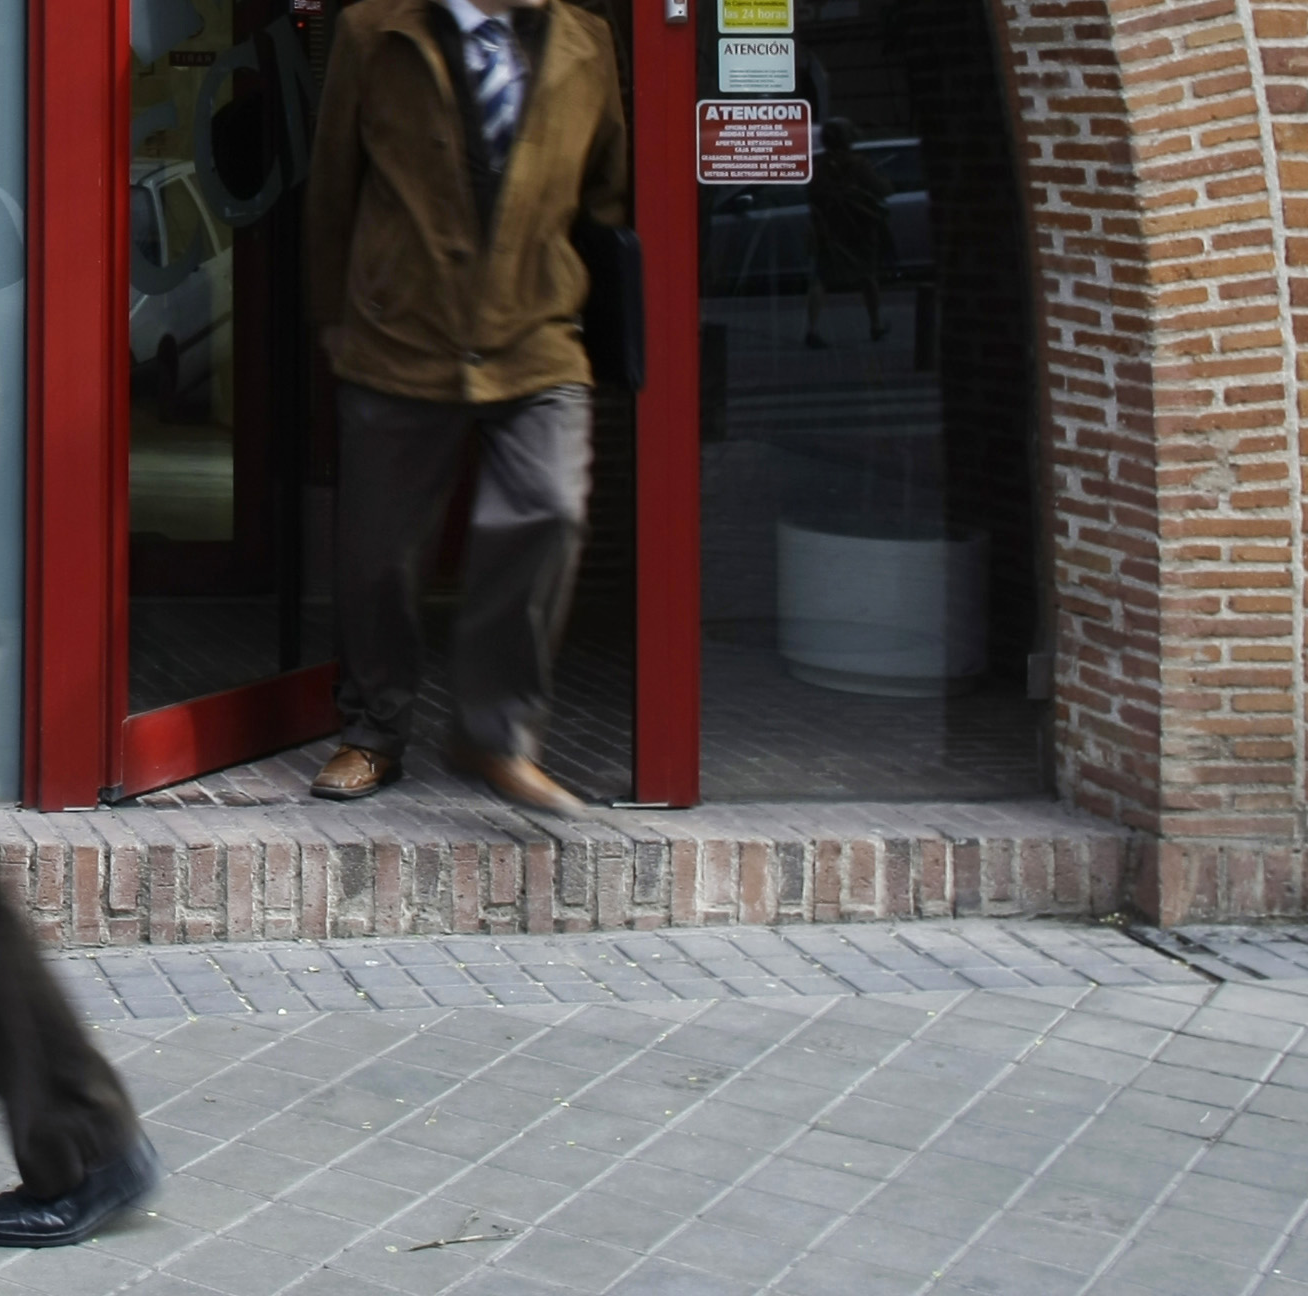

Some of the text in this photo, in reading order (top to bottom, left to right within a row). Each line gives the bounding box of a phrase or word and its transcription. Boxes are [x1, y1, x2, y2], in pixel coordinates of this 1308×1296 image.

[742, 8, 754, 19] 24
[757, 8, 787, 19] horas
[724, 41, 789, 55] ATENCIÓN
[705, 106, 802, 120] ATENCION
